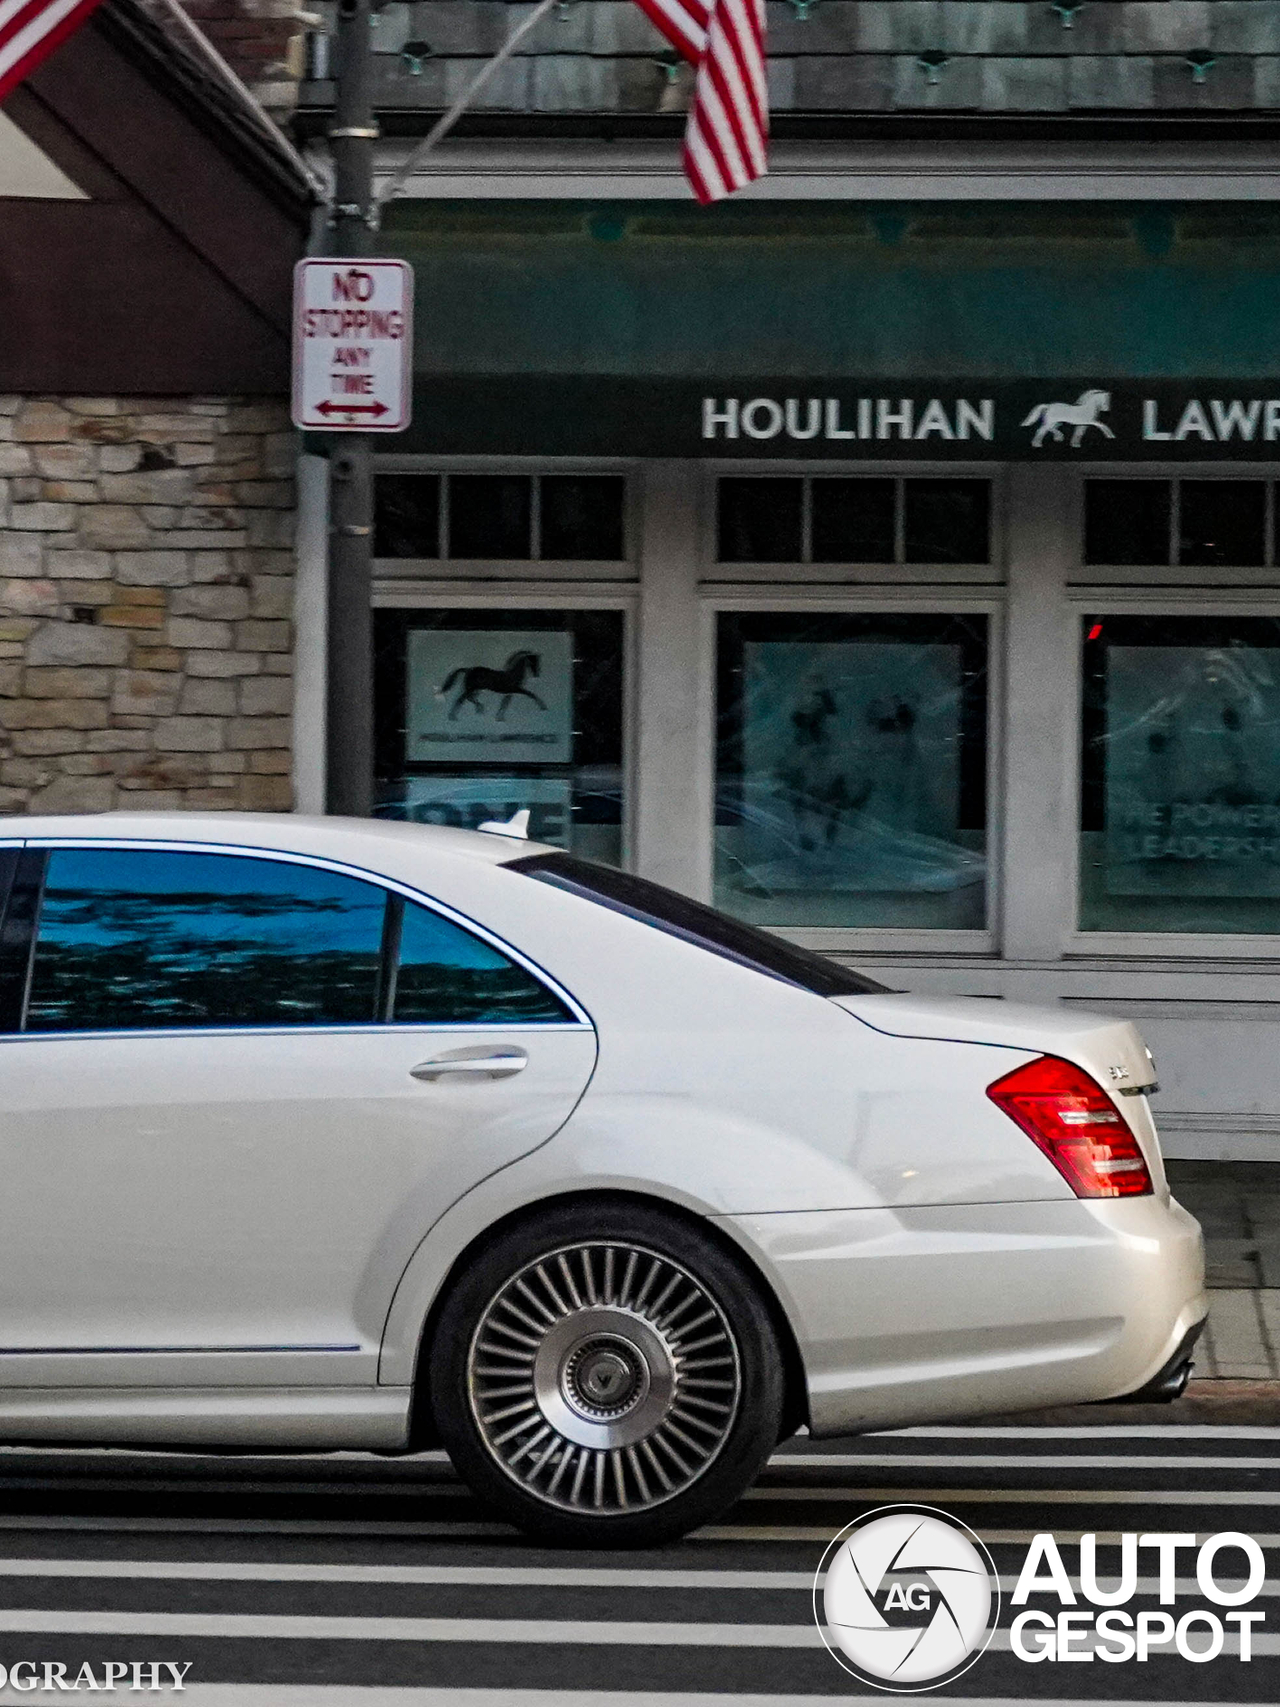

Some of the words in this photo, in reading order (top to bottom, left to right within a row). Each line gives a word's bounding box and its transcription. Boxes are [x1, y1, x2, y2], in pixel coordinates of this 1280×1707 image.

[332, 271, 375, 302] NO
[303, 309, 404, 340] STOPPING
[332, 347, 373, 367] ANY
[331, 374, 375, 394] TIME
[701, 398, 995, 440] HOULIHAN
